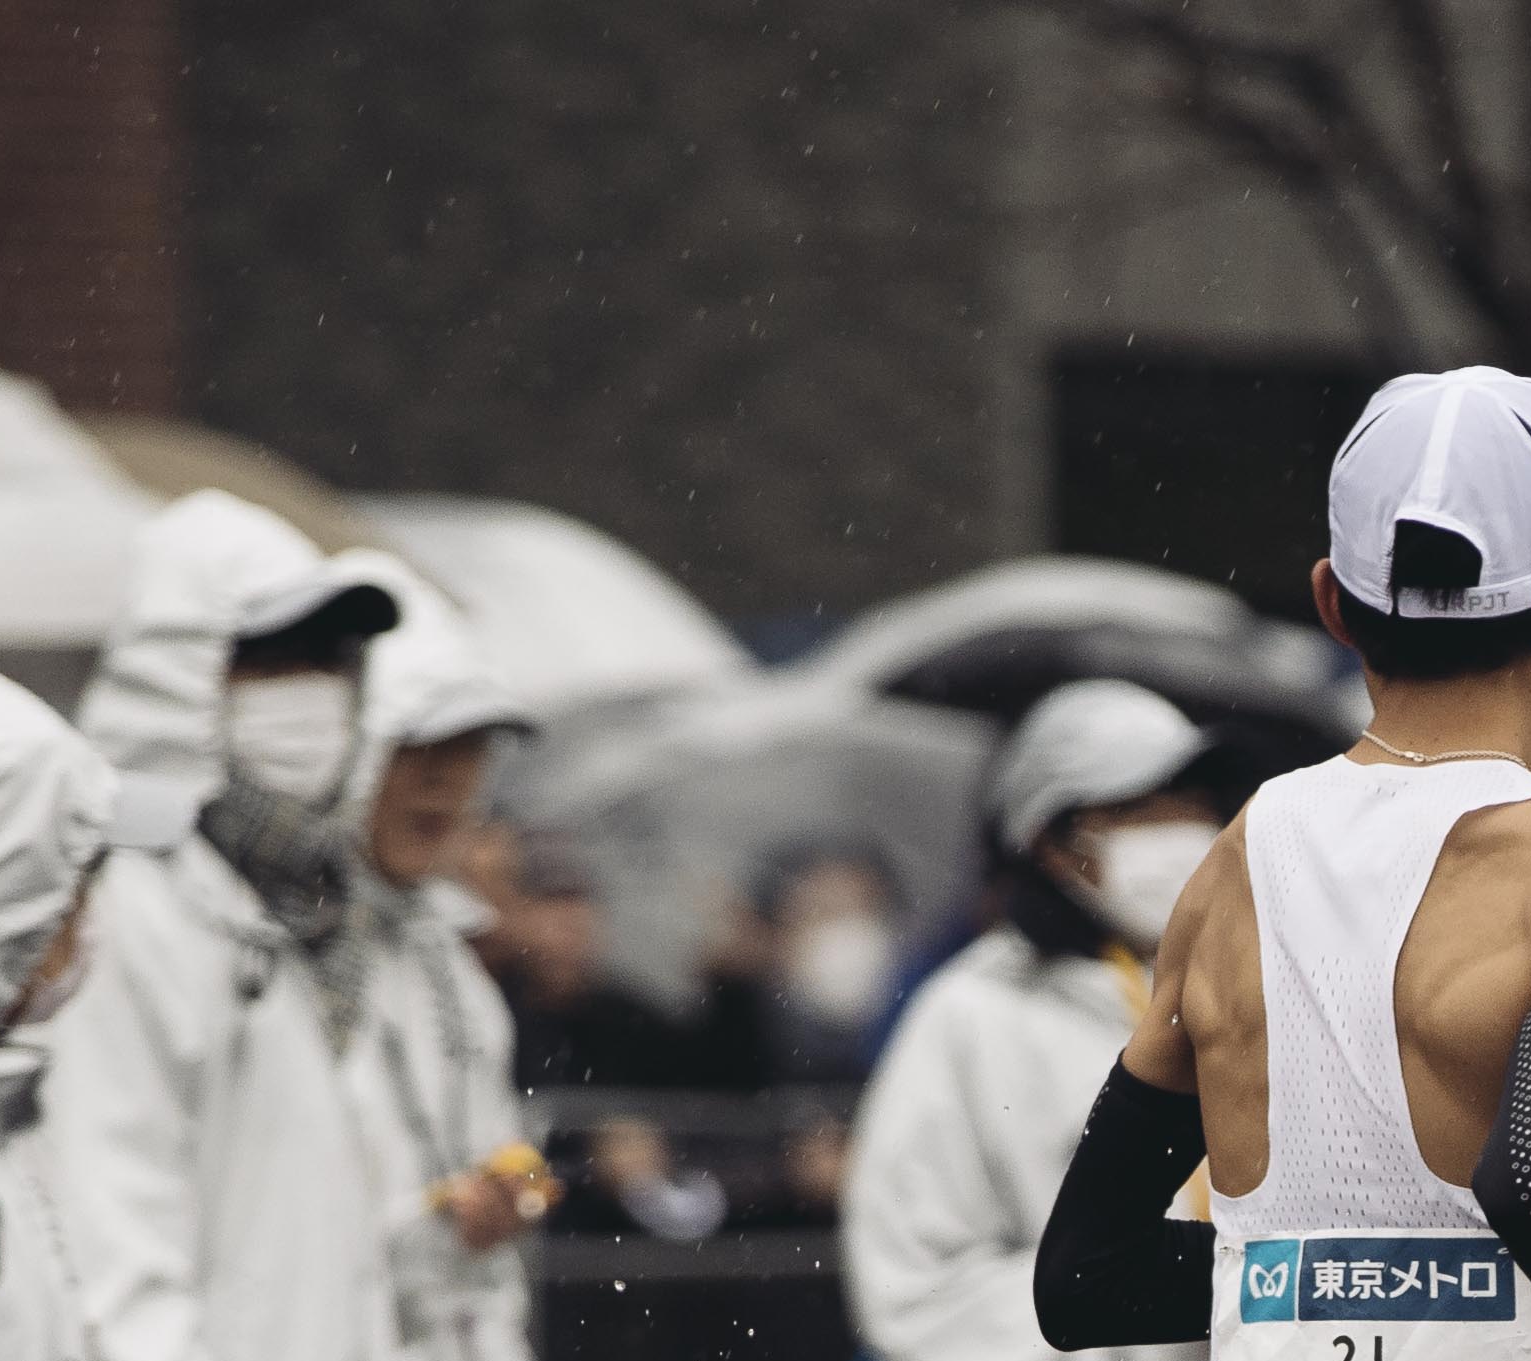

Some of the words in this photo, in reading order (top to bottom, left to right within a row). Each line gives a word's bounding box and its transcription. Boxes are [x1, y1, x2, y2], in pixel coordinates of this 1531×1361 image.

[1312, 1260, 1497, 1299] 東京メトロ
